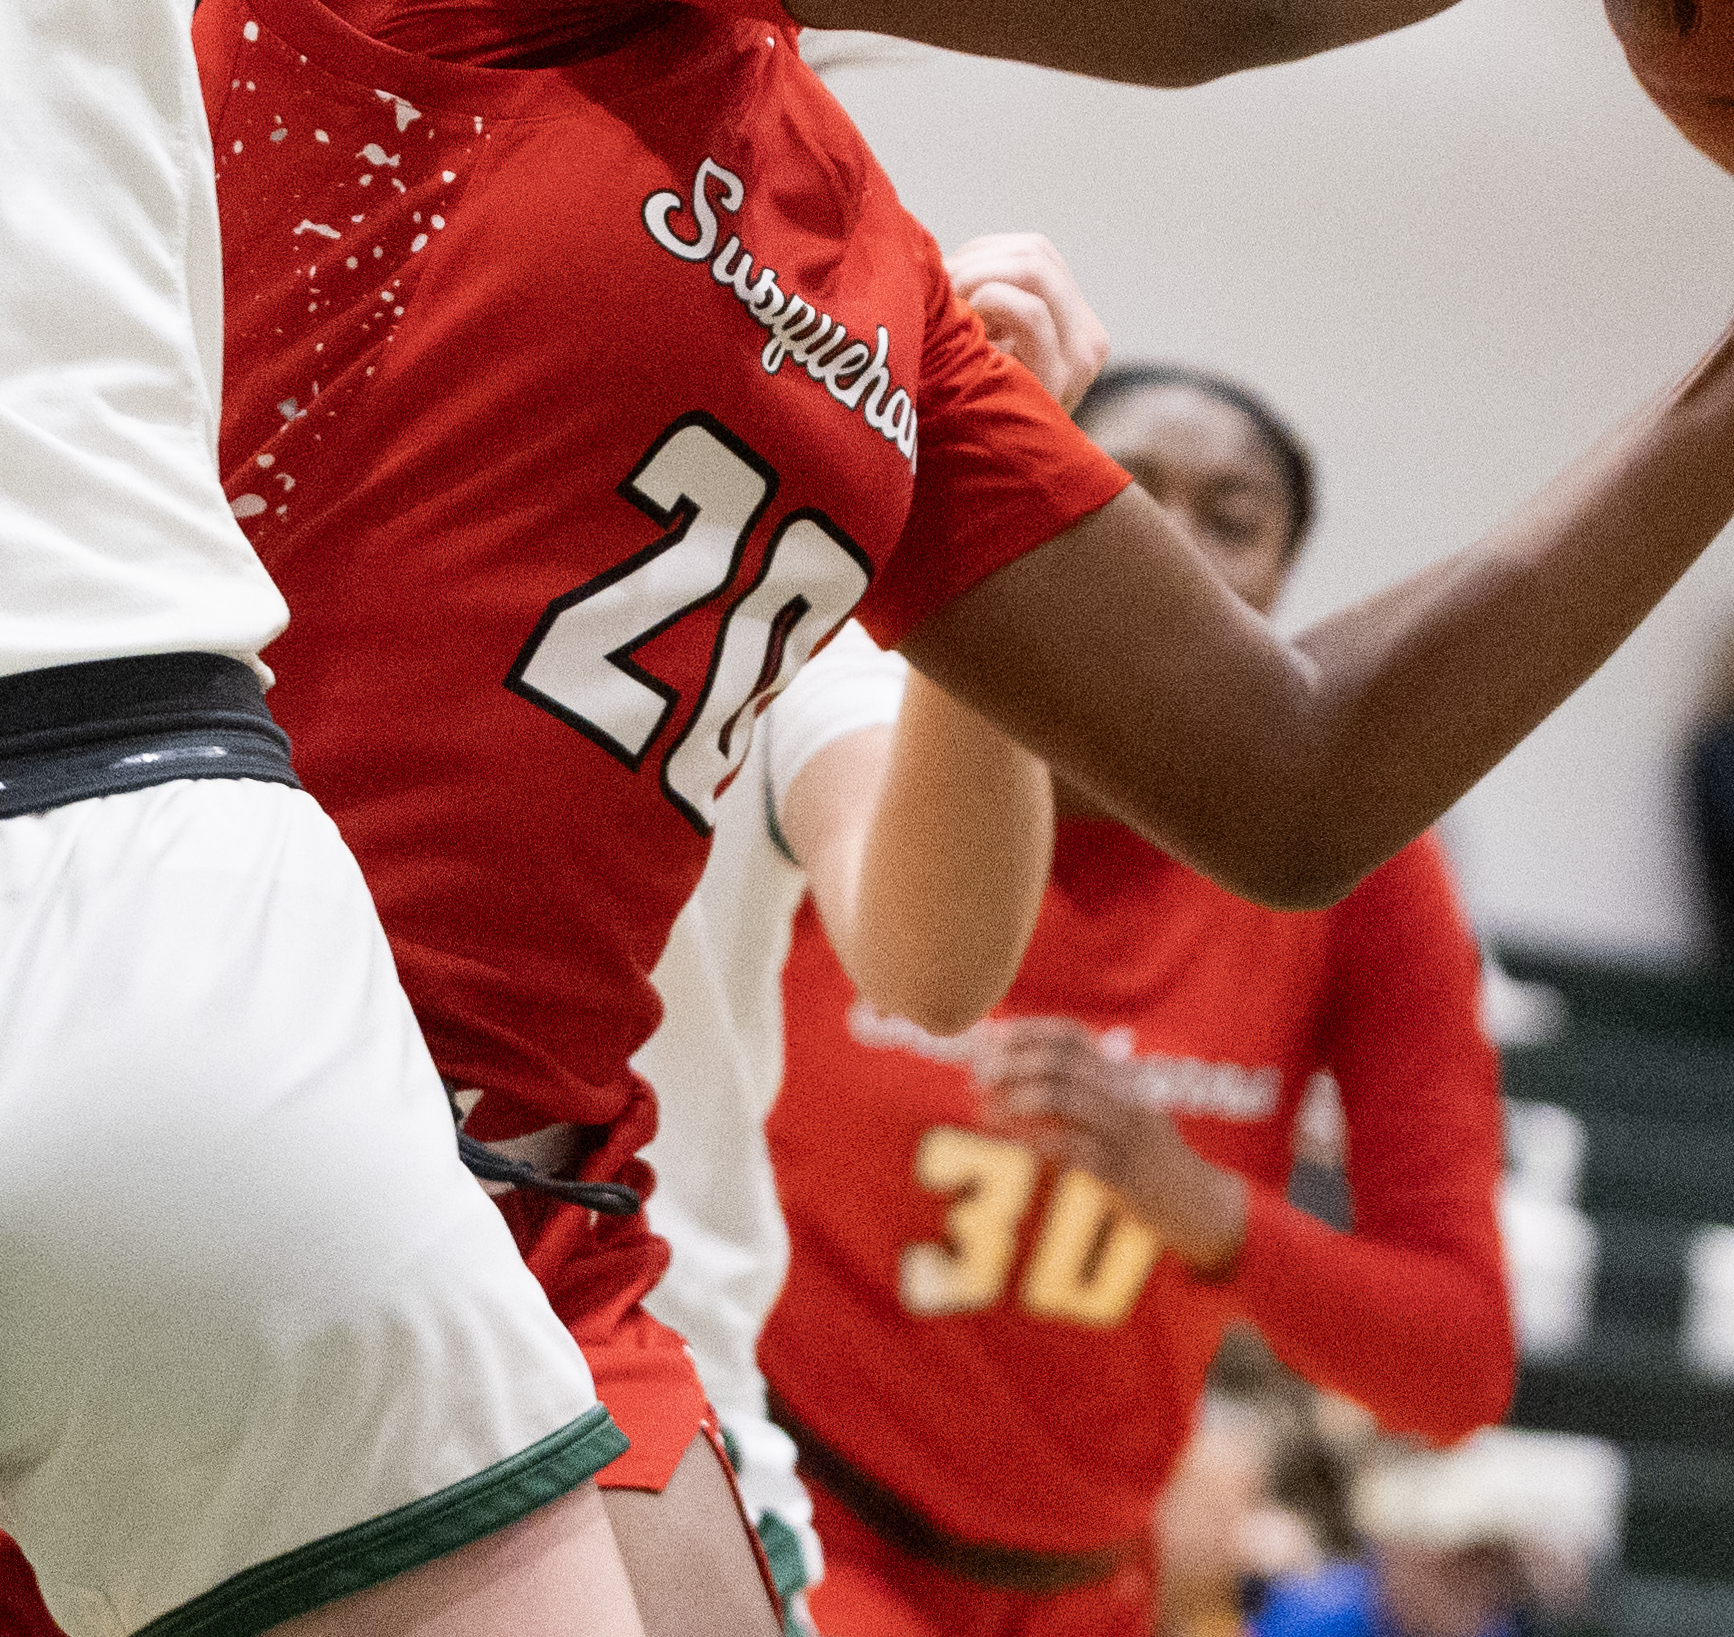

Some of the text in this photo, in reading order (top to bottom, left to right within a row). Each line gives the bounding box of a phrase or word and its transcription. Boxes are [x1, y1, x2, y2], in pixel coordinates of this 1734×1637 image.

[640, 157, 918, 475] Susqueha
[502, 410, 874, 838] 20
[898, 1125, 1163, 1330] 30
